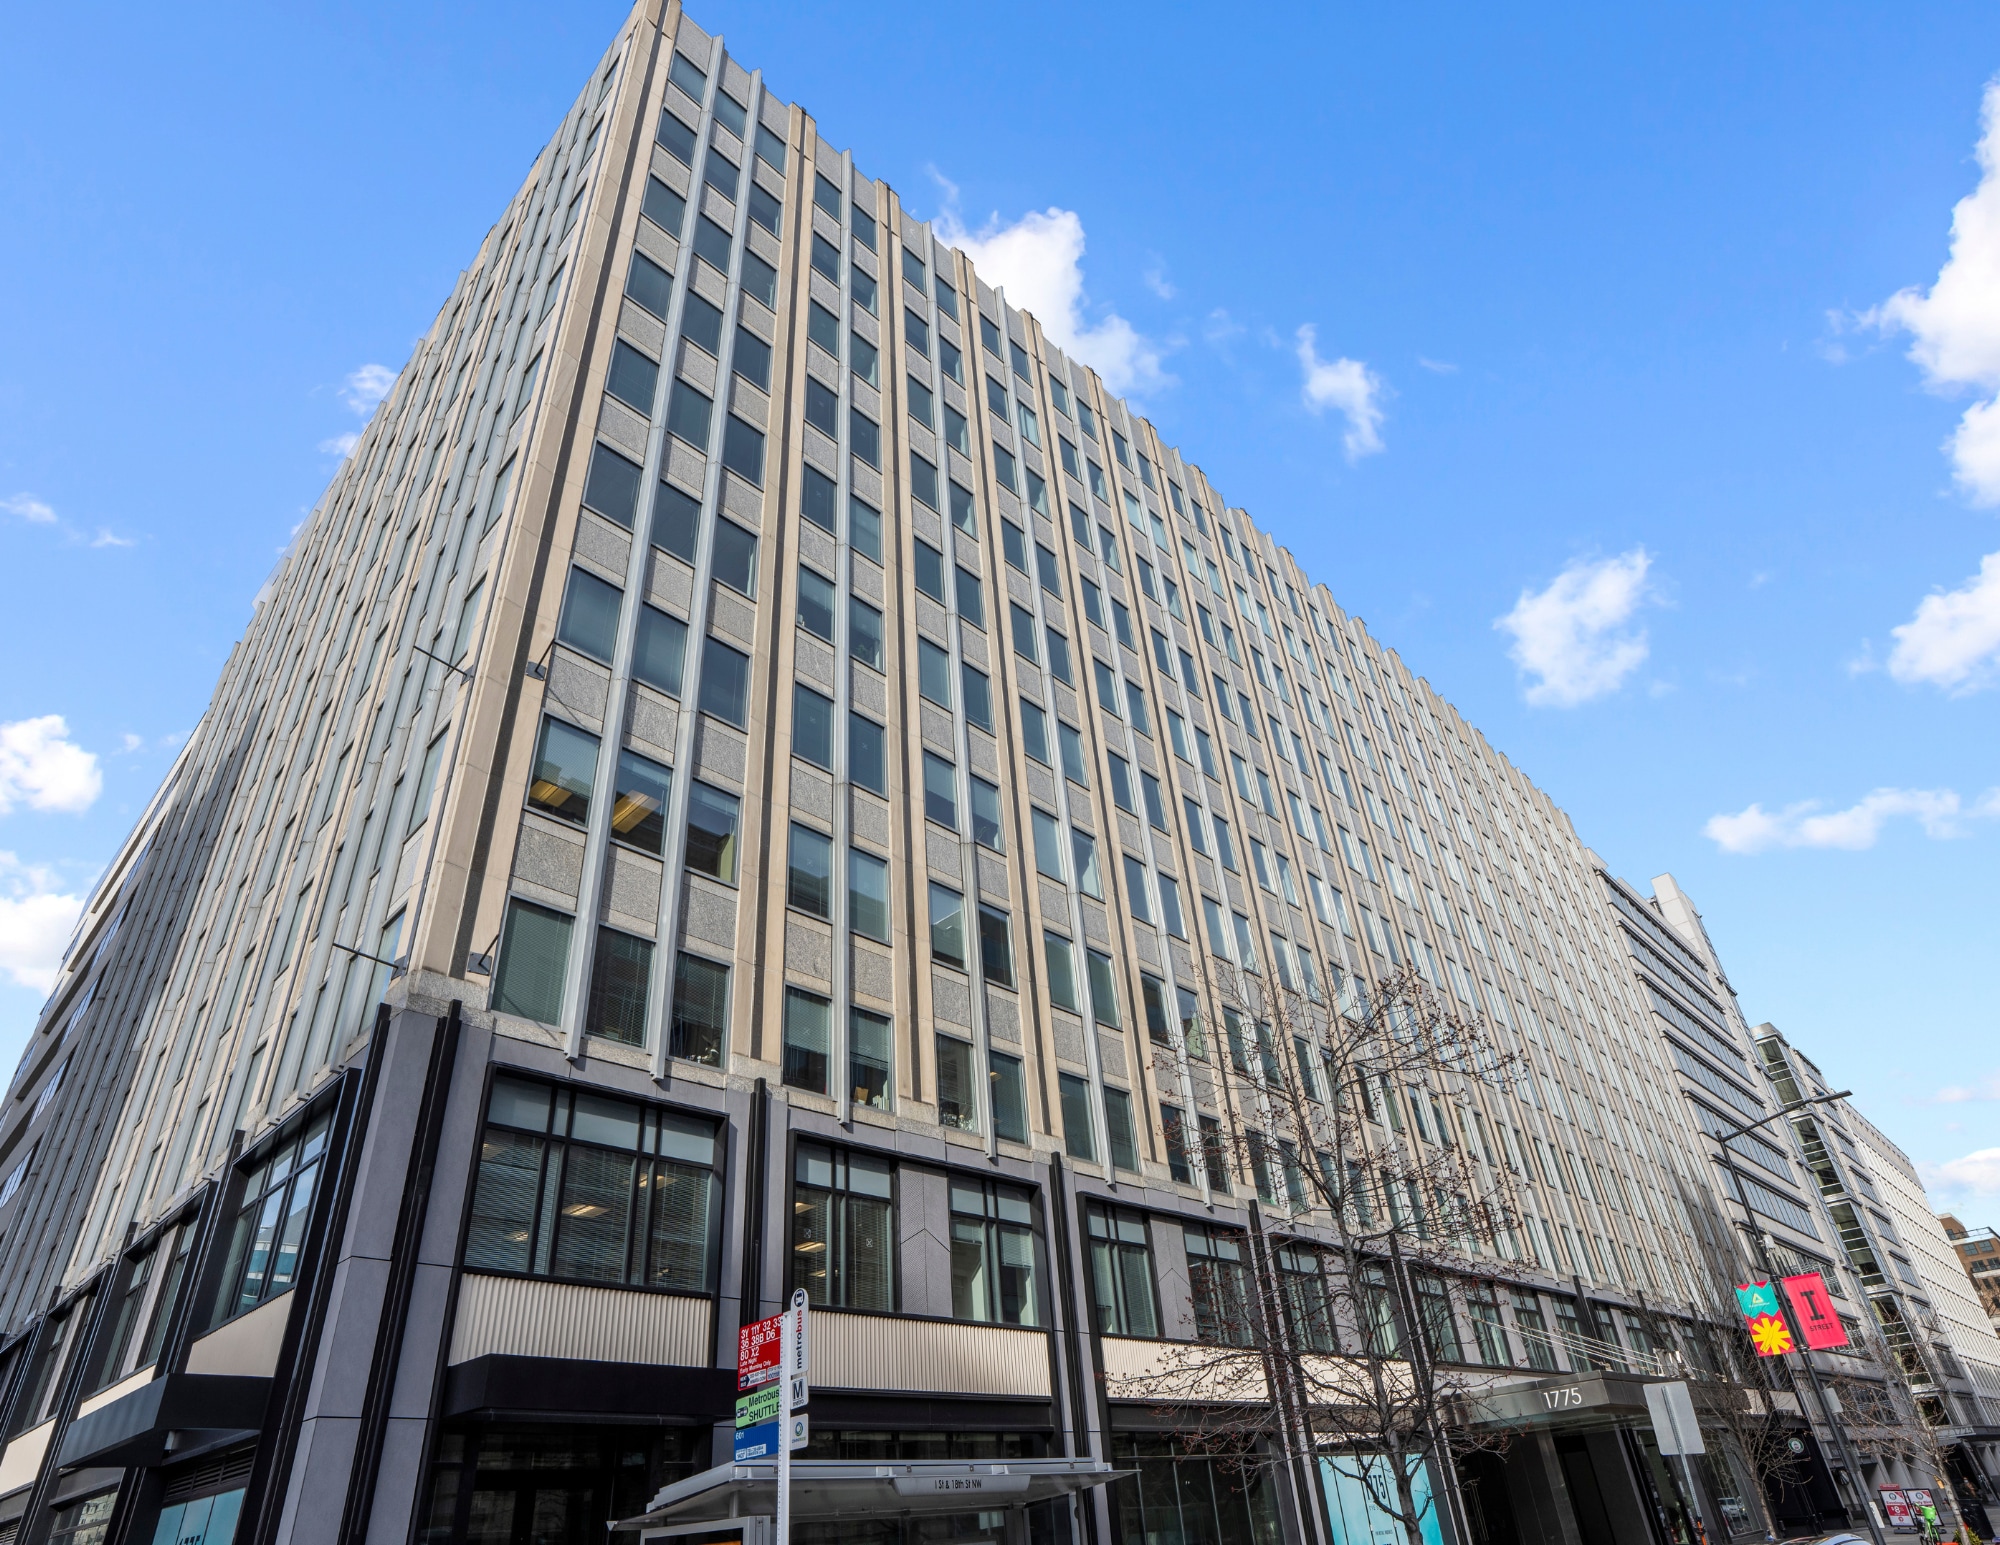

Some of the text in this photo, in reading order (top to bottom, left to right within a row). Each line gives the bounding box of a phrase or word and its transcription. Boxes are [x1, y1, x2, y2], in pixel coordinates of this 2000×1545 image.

[1800, 1290, 1825, 1321] I
[741, 1316, 782, 1340] 3Y 11Y 32 33
[1809, 1323, 1834, 1332] STREET
[741, 1338, 750, 1349] 36
[765, 1328, 776, 1340] D6
[795, 1309, 803, 1369] metrobus
[740, 1346, 760, 1361] 80 X2
[763, 1359, 772, 1367] Only
[748, 1389, 780, 1408] Metrobus
[792, 1379, 804, 1400] M
[1543, 1387, 1582, 1409] 1775
[748, 1402, 780, 1422] SHUTTLE
[735, 1431, 745, 1441] 601
[938, 1479, 944, 1490] St
[945, 1480, 950, 1489] &
[951, 1479, 965, 1489] 18th
[965, 1479, 971, 1489] St
[971, 1479, 982, 1489] NW
